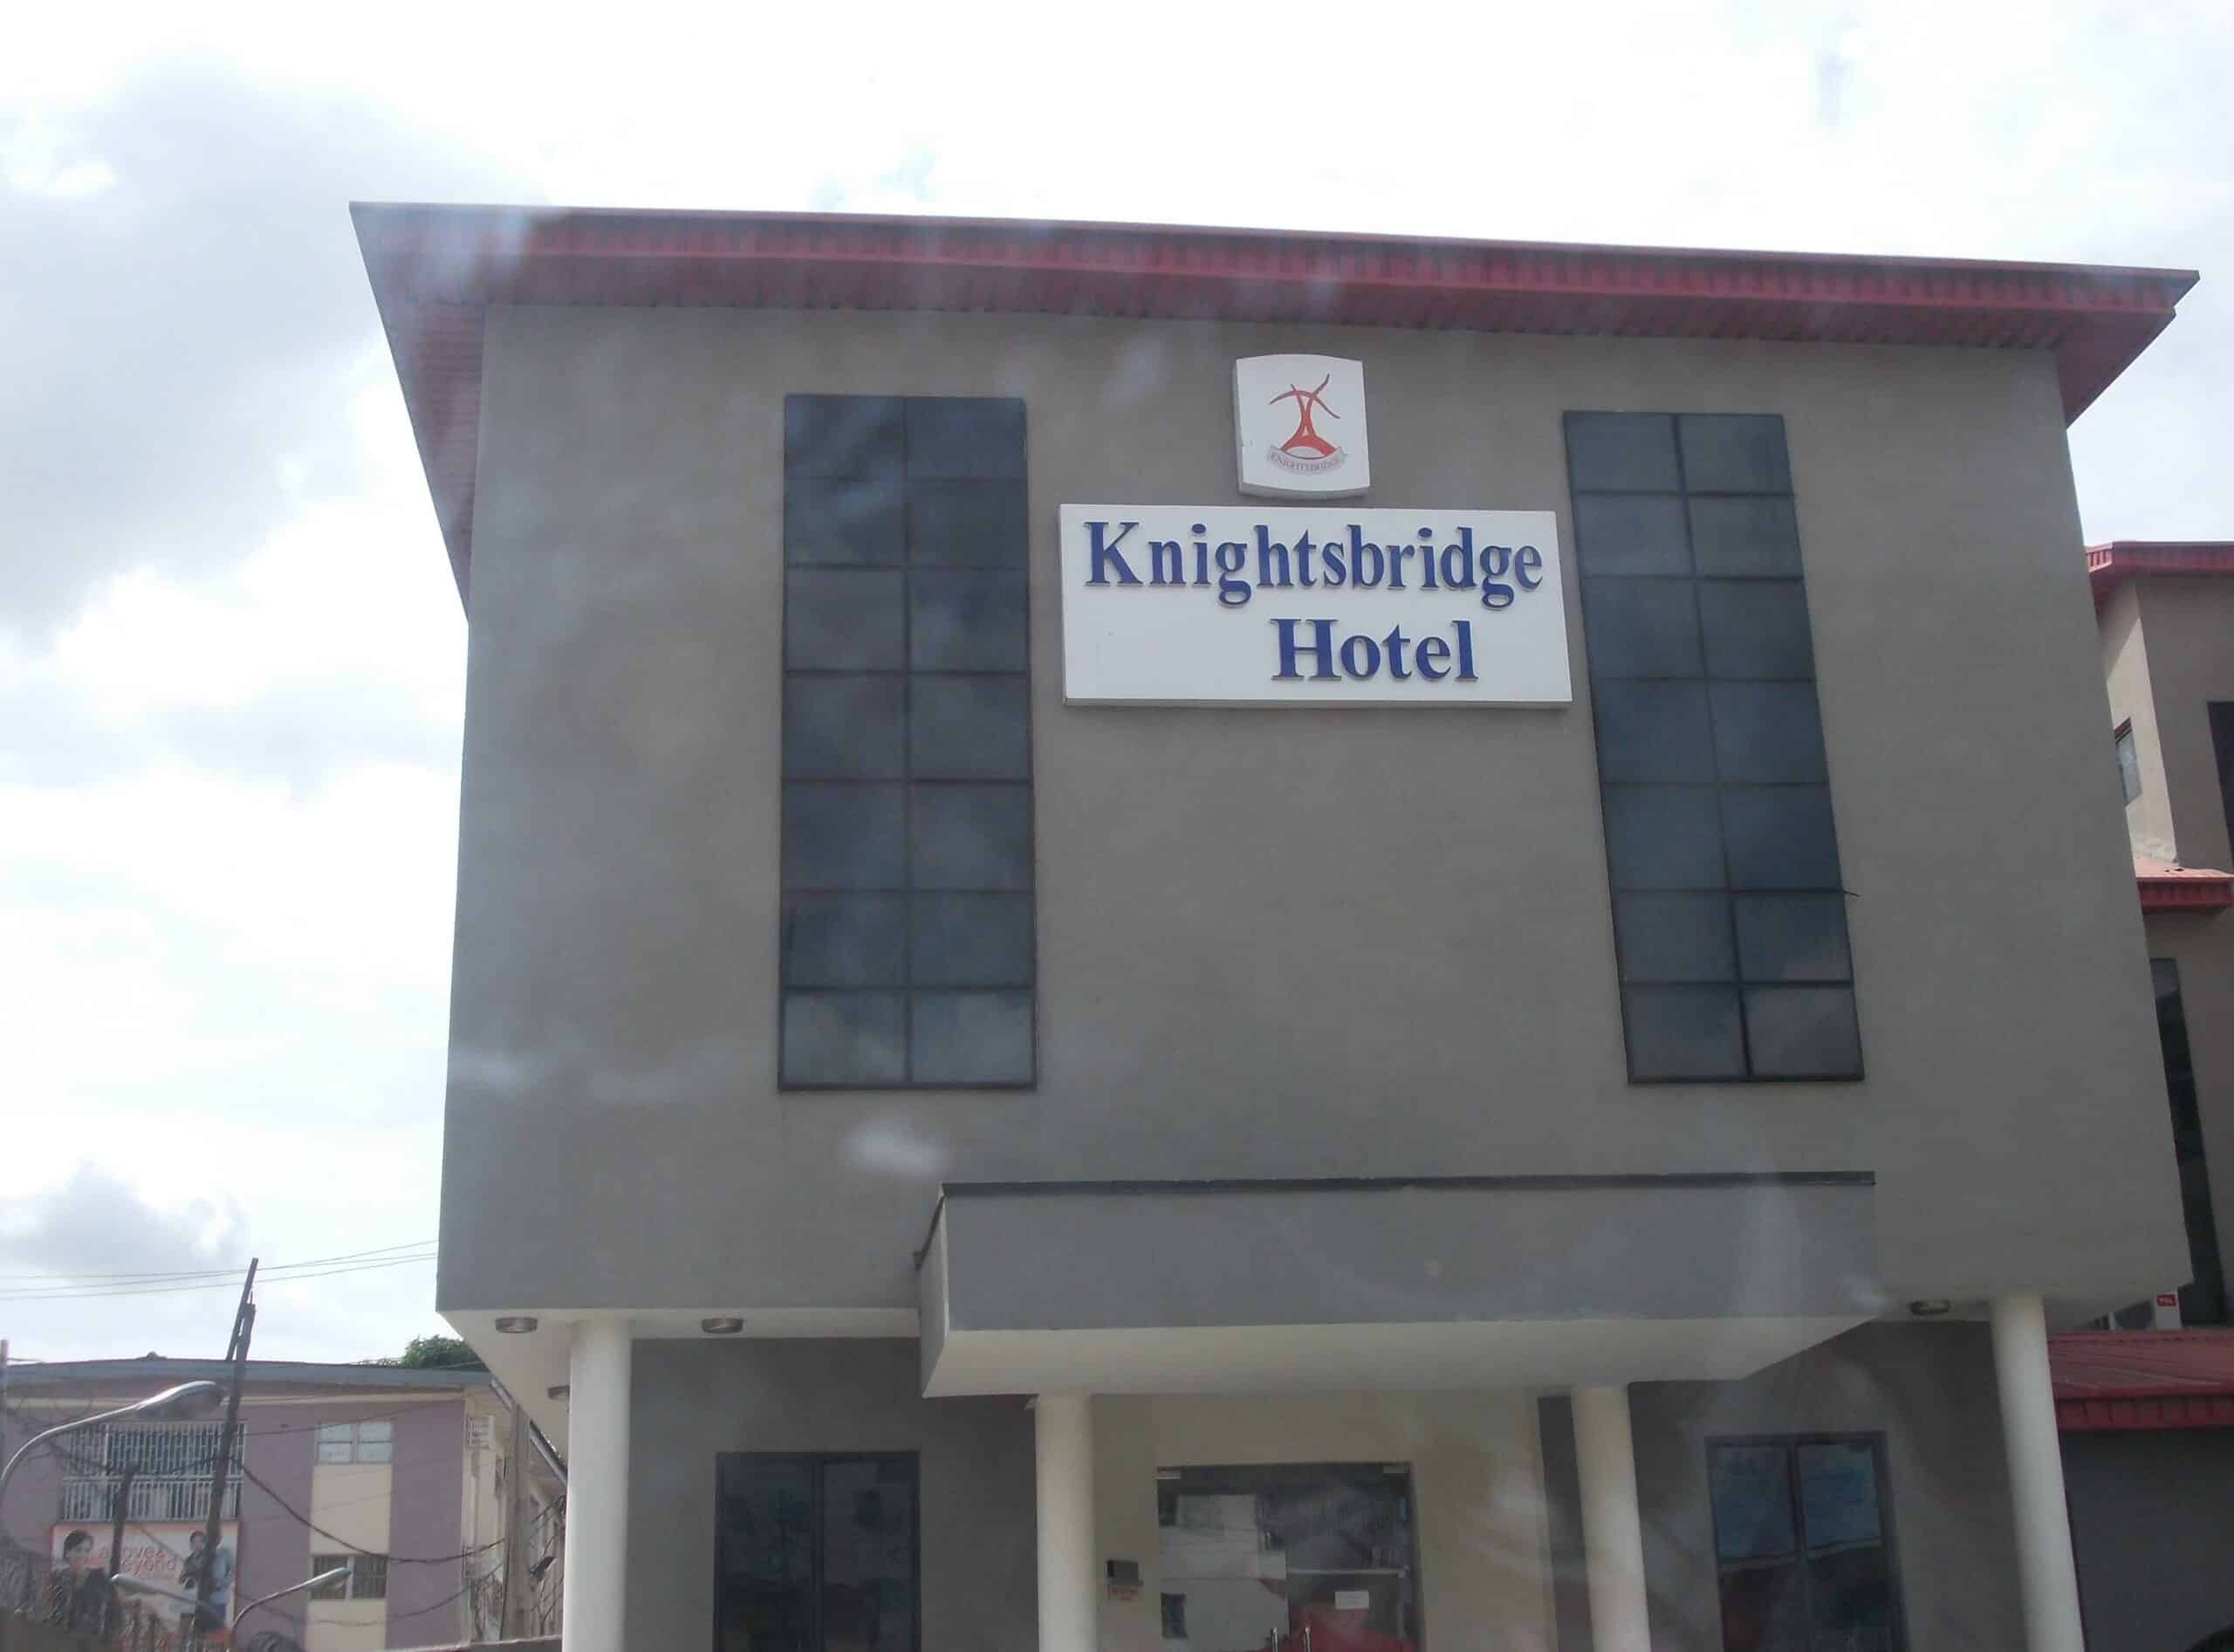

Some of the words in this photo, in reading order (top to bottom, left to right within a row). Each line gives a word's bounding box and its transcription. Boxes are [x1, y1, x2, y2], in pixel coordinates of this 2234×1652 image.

[1083, 521, 1543, 609] Knightsbridge
[1270, 617, 1478, 680] Hotel
[99, 1547, 154, 1559] aove
[119, 1557, 177, 1575] eyond
